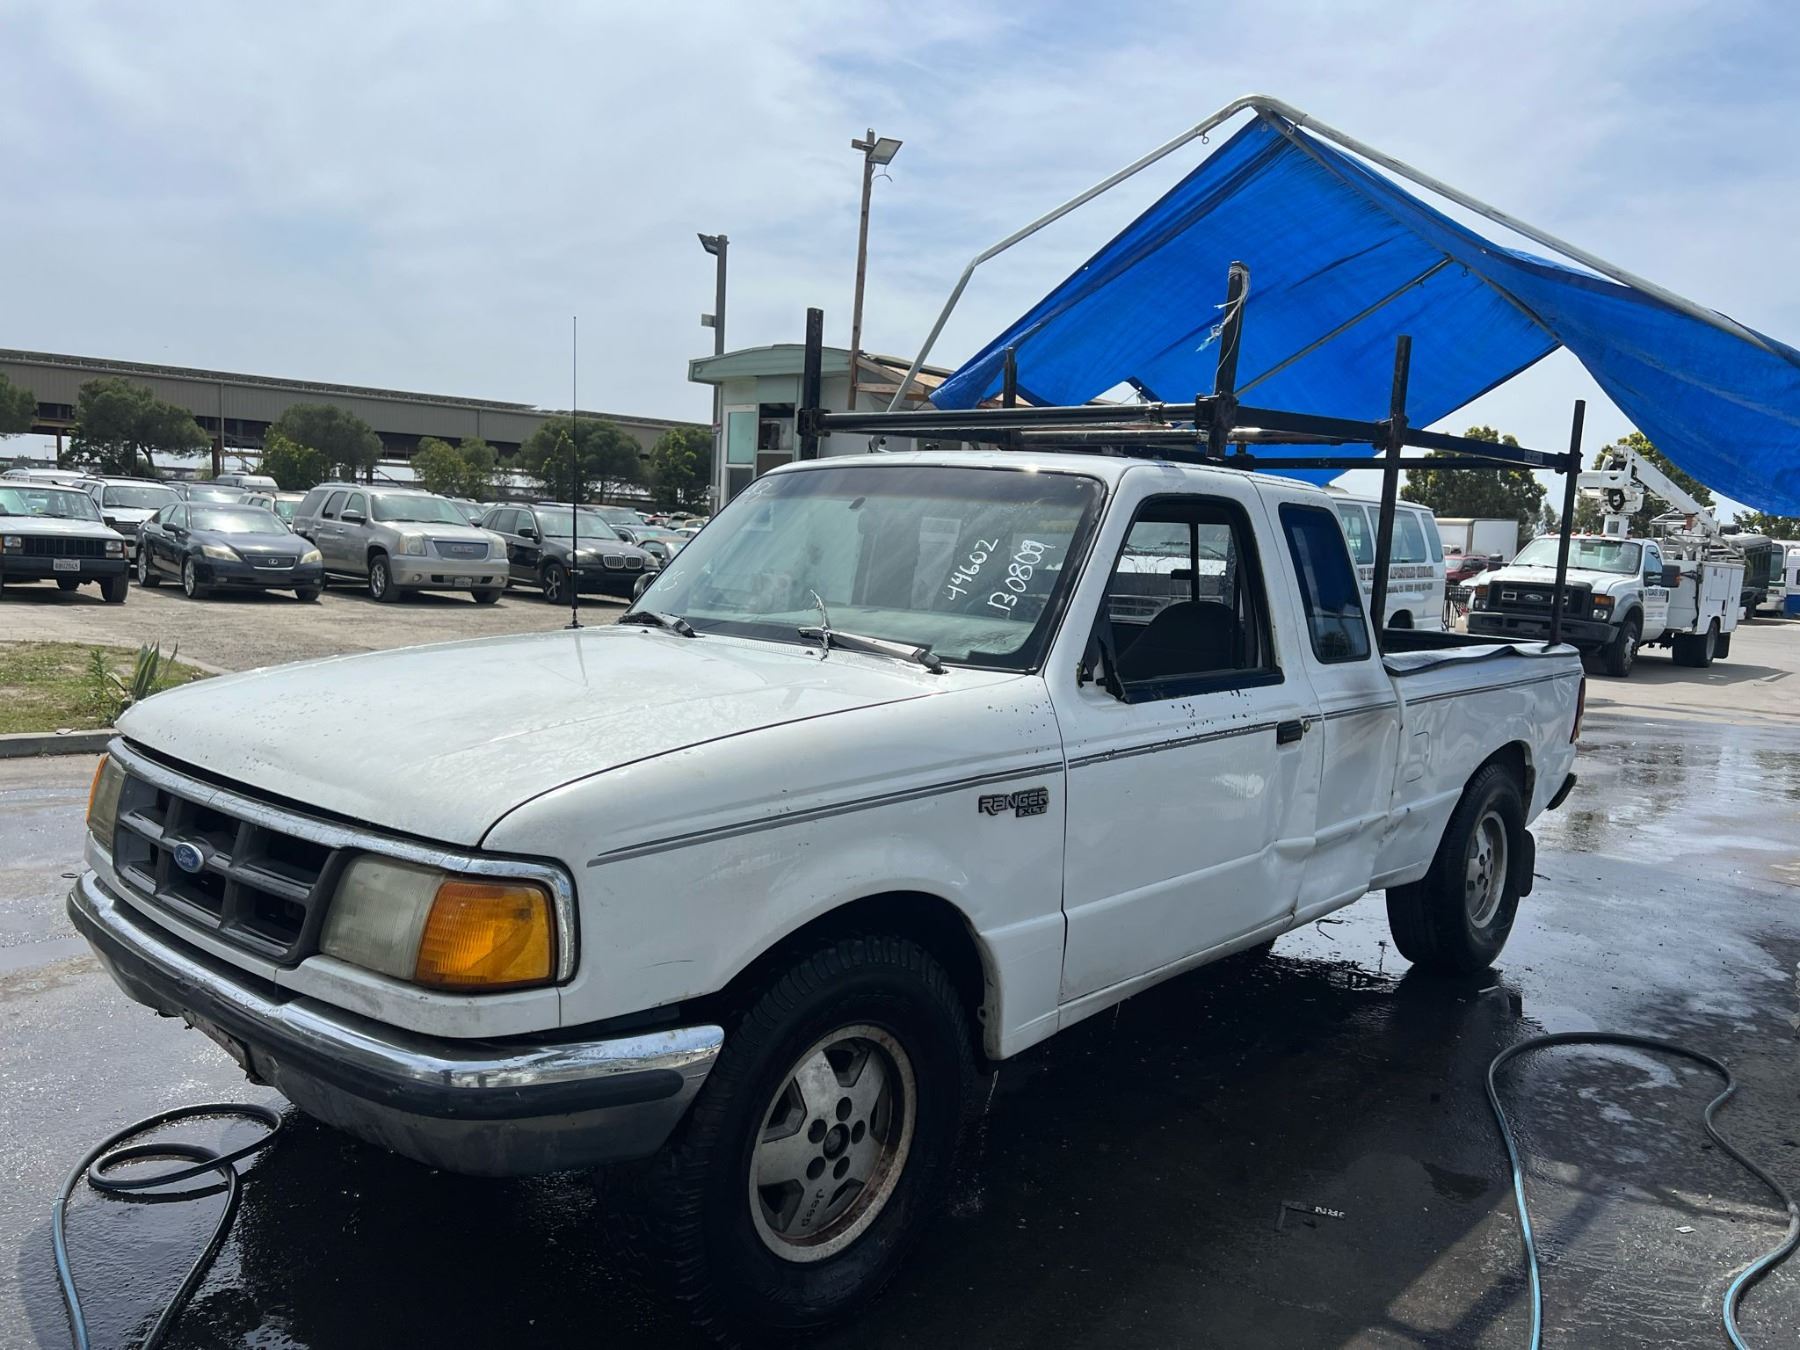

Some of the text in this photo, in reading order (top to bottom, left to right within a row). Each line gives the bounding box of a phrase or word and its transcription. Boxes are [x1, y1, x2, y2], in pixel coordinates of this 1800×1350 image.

[947, 538, 999, 601] 44602
[978, 787, 1049, 816] RANGER
[1021, 804, 1045, 816] XLT
[801, 1188, 825, 1227] Jeep
